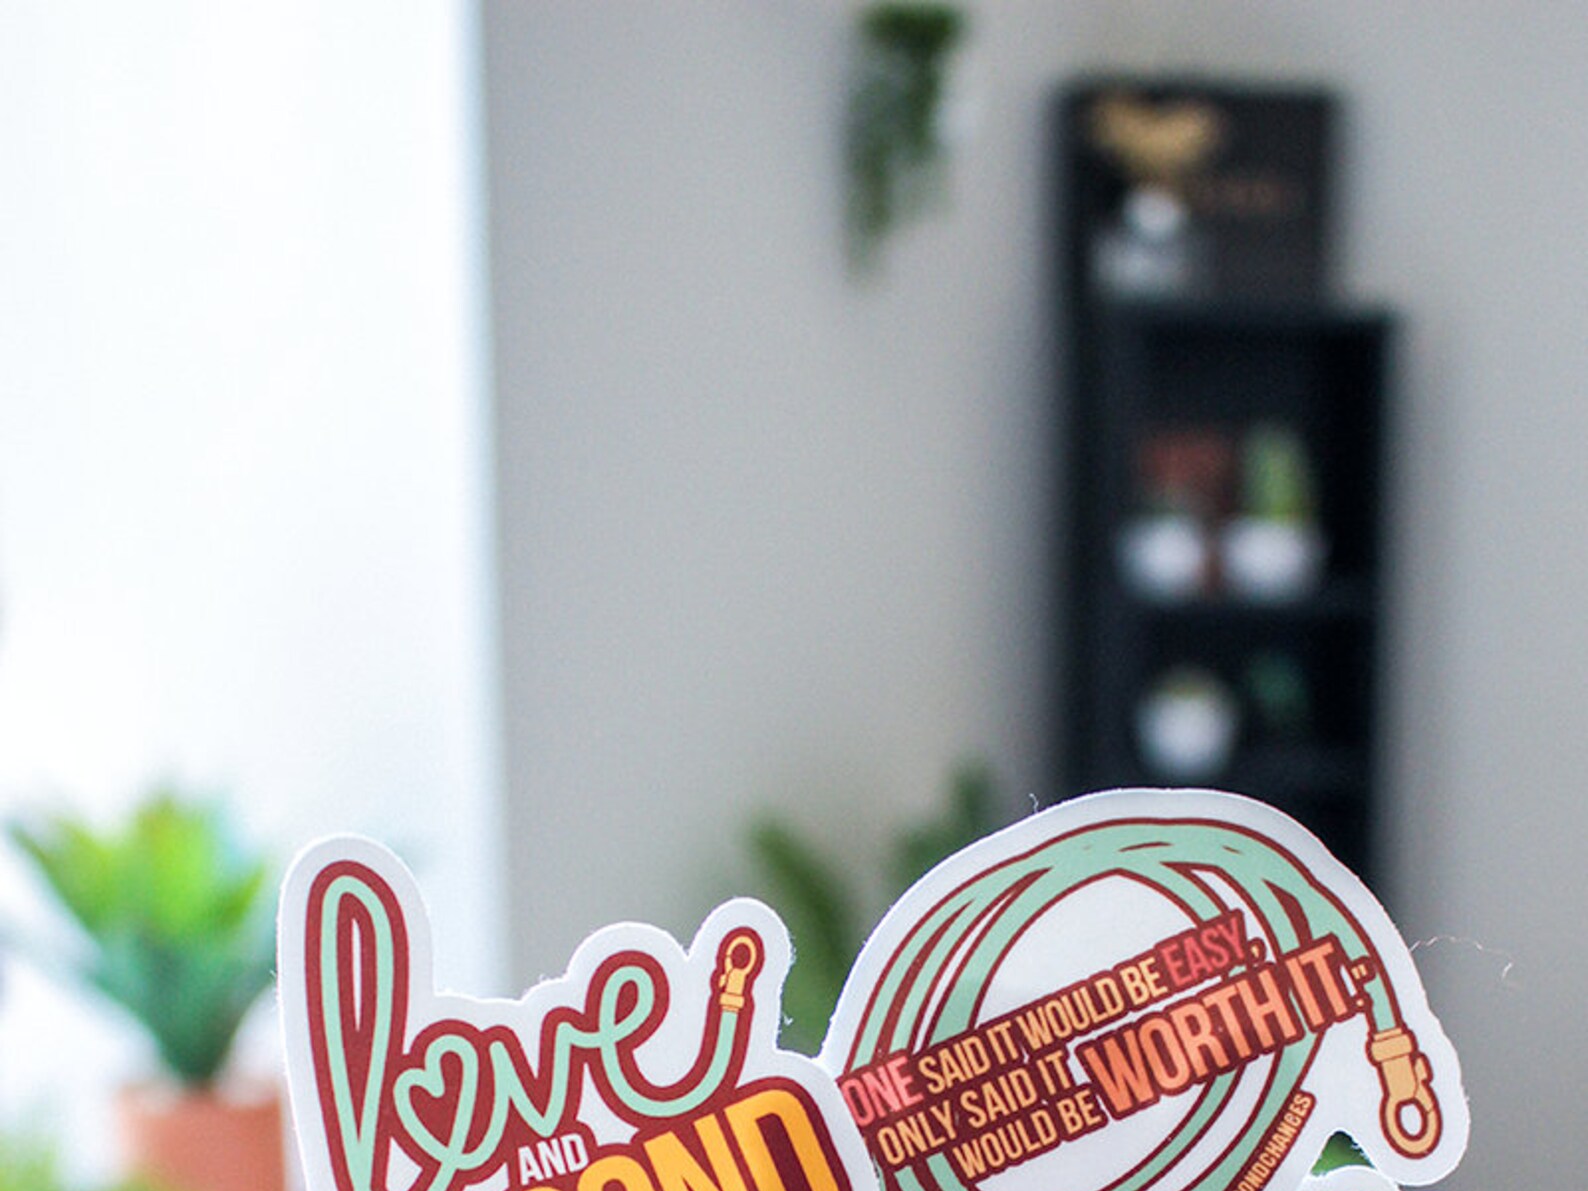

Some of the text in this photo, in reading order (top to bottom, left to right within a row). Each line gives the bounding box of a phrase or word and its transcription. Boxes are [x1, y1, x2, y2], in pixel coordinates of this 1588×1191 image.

[840, 916, 1260, 1127] ONE SAID IT WOULD BE EASY,
[952, 1109, 1058, 1180] WOULD
[1056, 1089, 1102, 1135] BE
[1083, 968, 1298, 1114] WORTH
[517, 1133, 590, 1187] AND
[877, 1050, 1072, 1165] ONLY SAID IT
